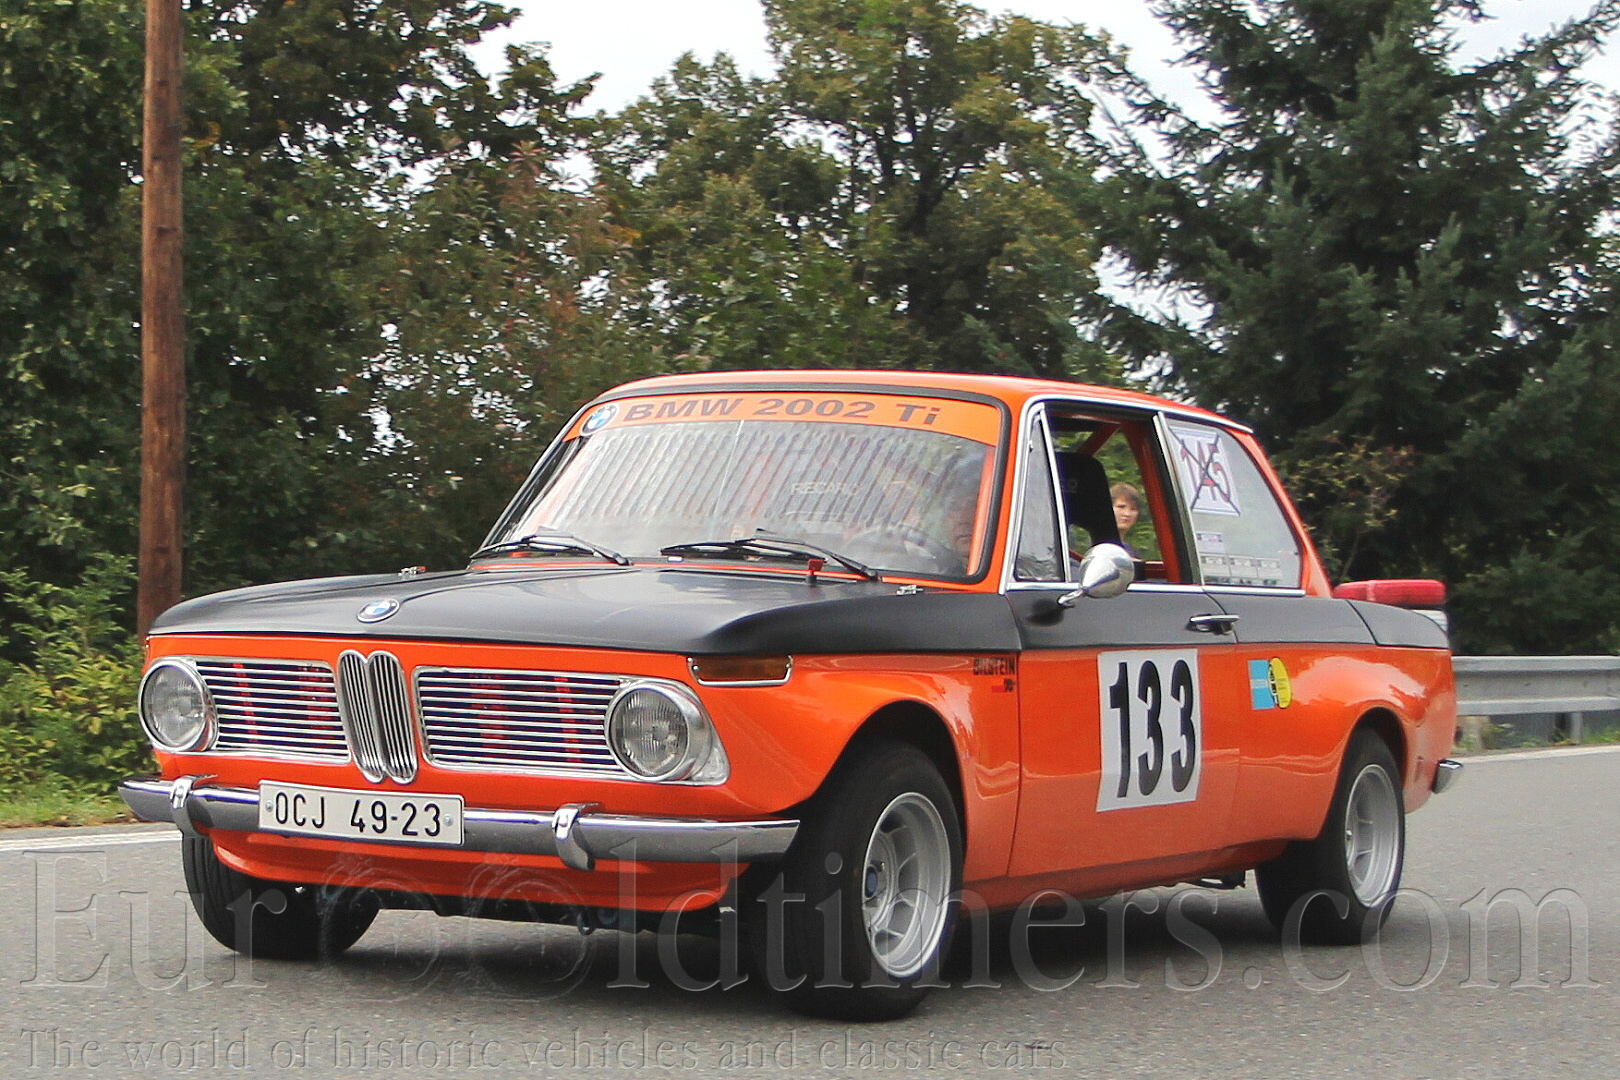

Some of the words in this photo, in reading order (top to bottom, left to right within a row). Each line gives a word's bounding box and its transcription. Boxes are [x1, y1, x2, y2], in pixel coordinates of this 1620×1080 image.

[625, 398, 742, 420] BMW
[754, 399, 875, 418] 2002
[894, 404, 940, 425] Ti
[1109, 659, 1197, 798] 133
[350, 800, 441, 836] 49-23
